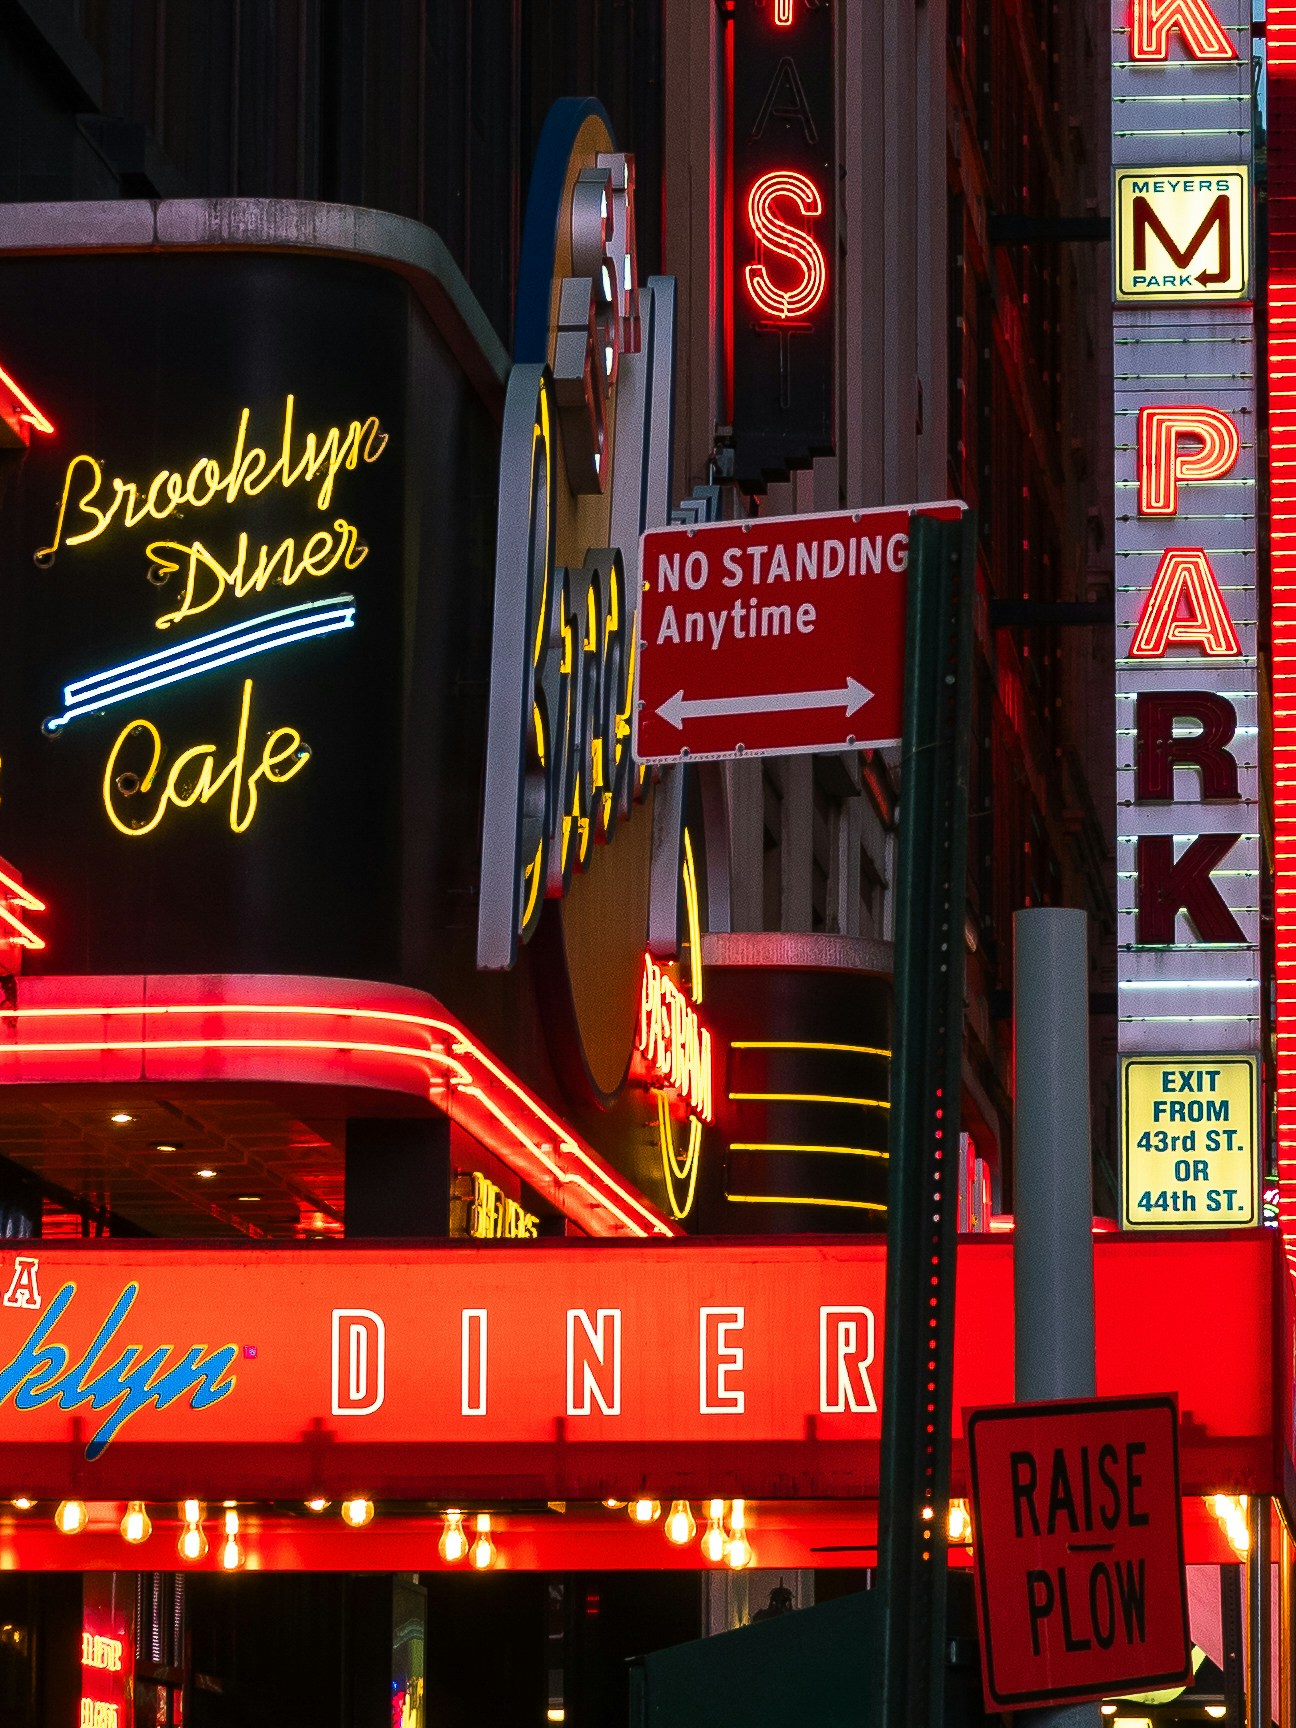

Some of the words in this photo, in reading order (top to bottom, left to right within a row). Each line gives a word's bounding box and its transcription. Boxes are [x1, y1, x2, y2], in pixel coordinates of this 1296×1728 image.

[1131, 179, 1231, 193] MEYERS
[1132, 194, 1232, 285] M
[1132, 275, 1193, 288] PARK
[35, 394, 389, 558] Brooklyn
[147, 518, 369, 630] Diner
[657, 550, 709, 593] NO
[721, 531, 909, 589] STANDING
[656, 598, 817, 650] Anytime
[1127, 405, 1250, 945] PARK
[103, 678, 312, 836] Cafe
[1152, 1100, 1230, 1123] FROM
[1161, 1071, 1220, 1093] EXIT
[1136, 1129, 1196, 1153] 43rd
[1205, 1129, 1244, 1153] ST.
[1174, 1159, 1210, 1182] OR
[1137, 1189, 1195, 1212] 44th
[1205, 1189, 1244, 1212] ST.
[331, 1305, 878, 1416] DINER
[1009, 1441, 1149, 1539] RAISE
[1026, 1557, 1147, 1658] PLOW
